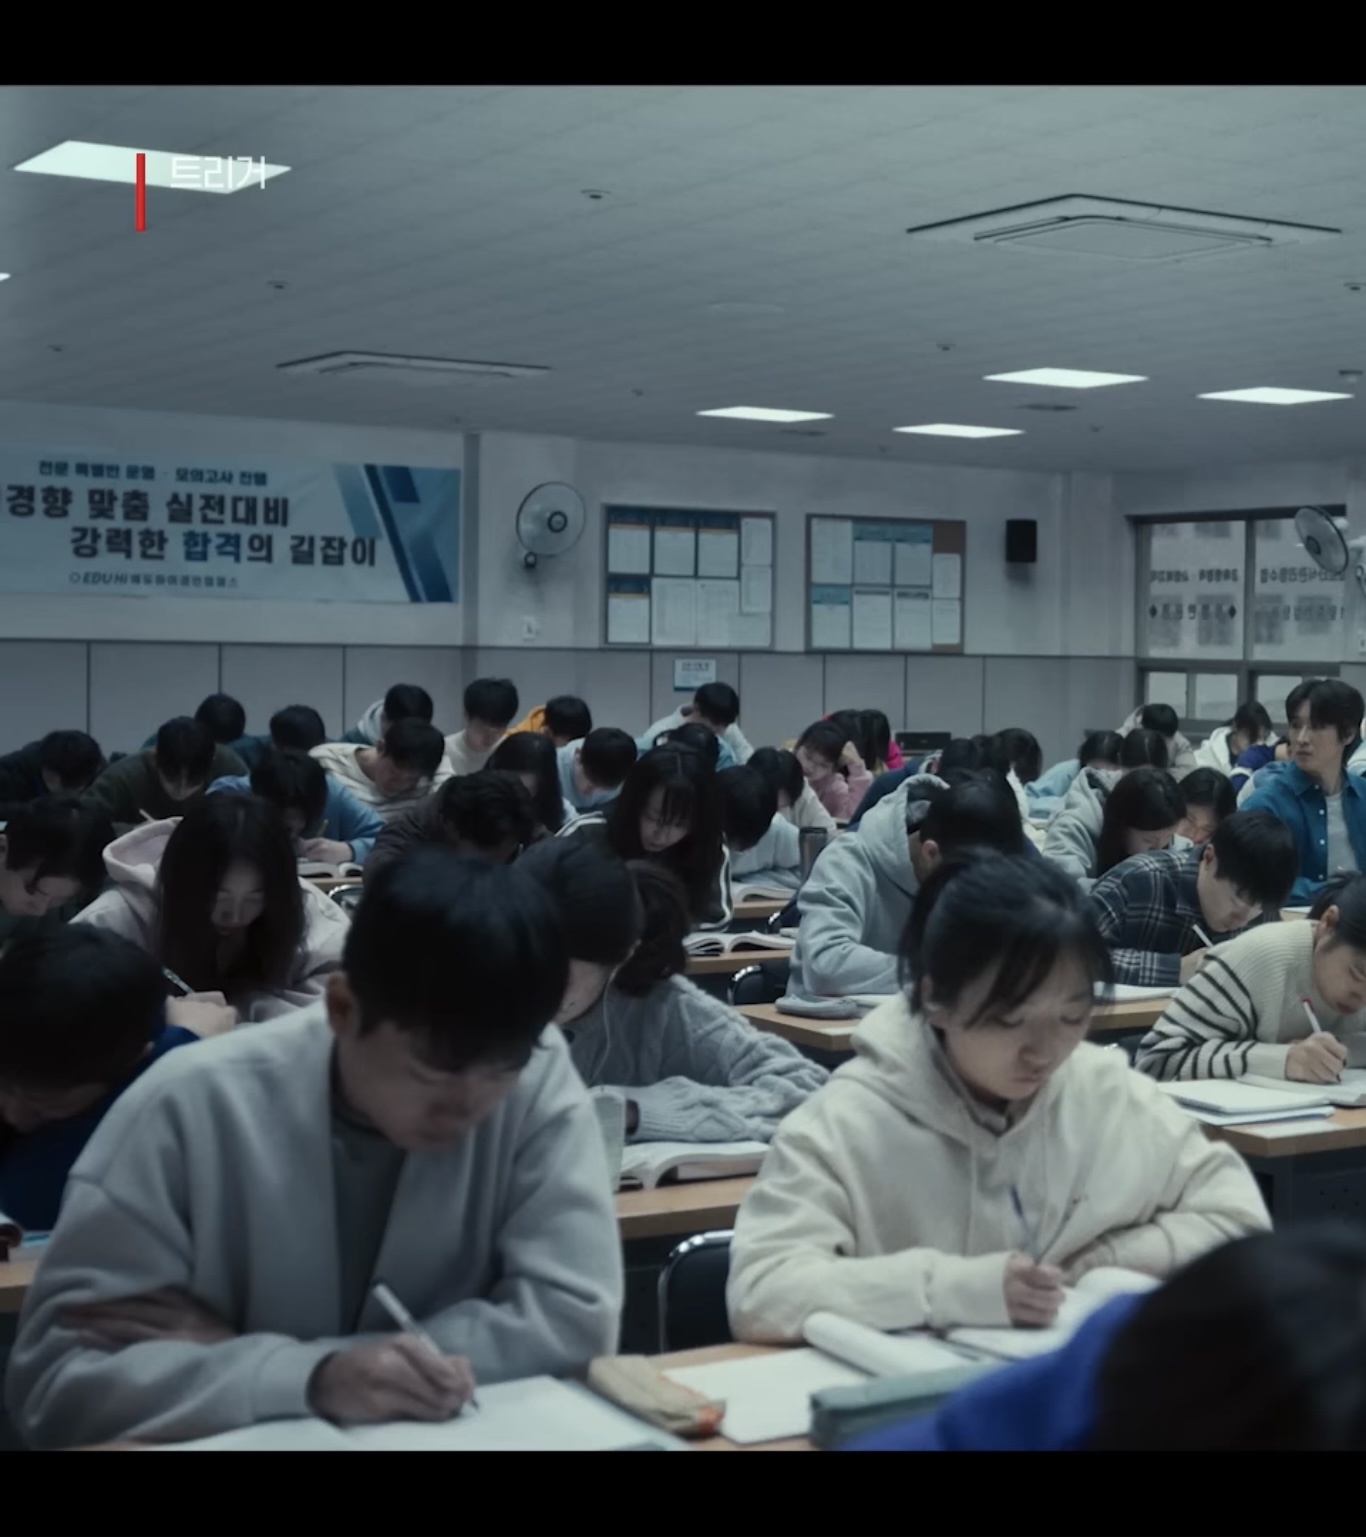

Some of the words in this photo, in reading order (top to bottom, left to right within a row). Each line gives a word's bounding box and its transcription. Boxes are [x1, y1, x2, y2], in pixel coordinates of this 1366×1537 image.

[175, 467, 233, 486] 모의고사
[0, 484, 73, 520] 경향
[88, 488, 150, 523] 맞춤
[166, 492, 289, 528] 실전대비
[70, 526, 169, 561] 강력한
[183, 531, 275, 564] 합격의
[289, 534, 376, 568] 길잡이
